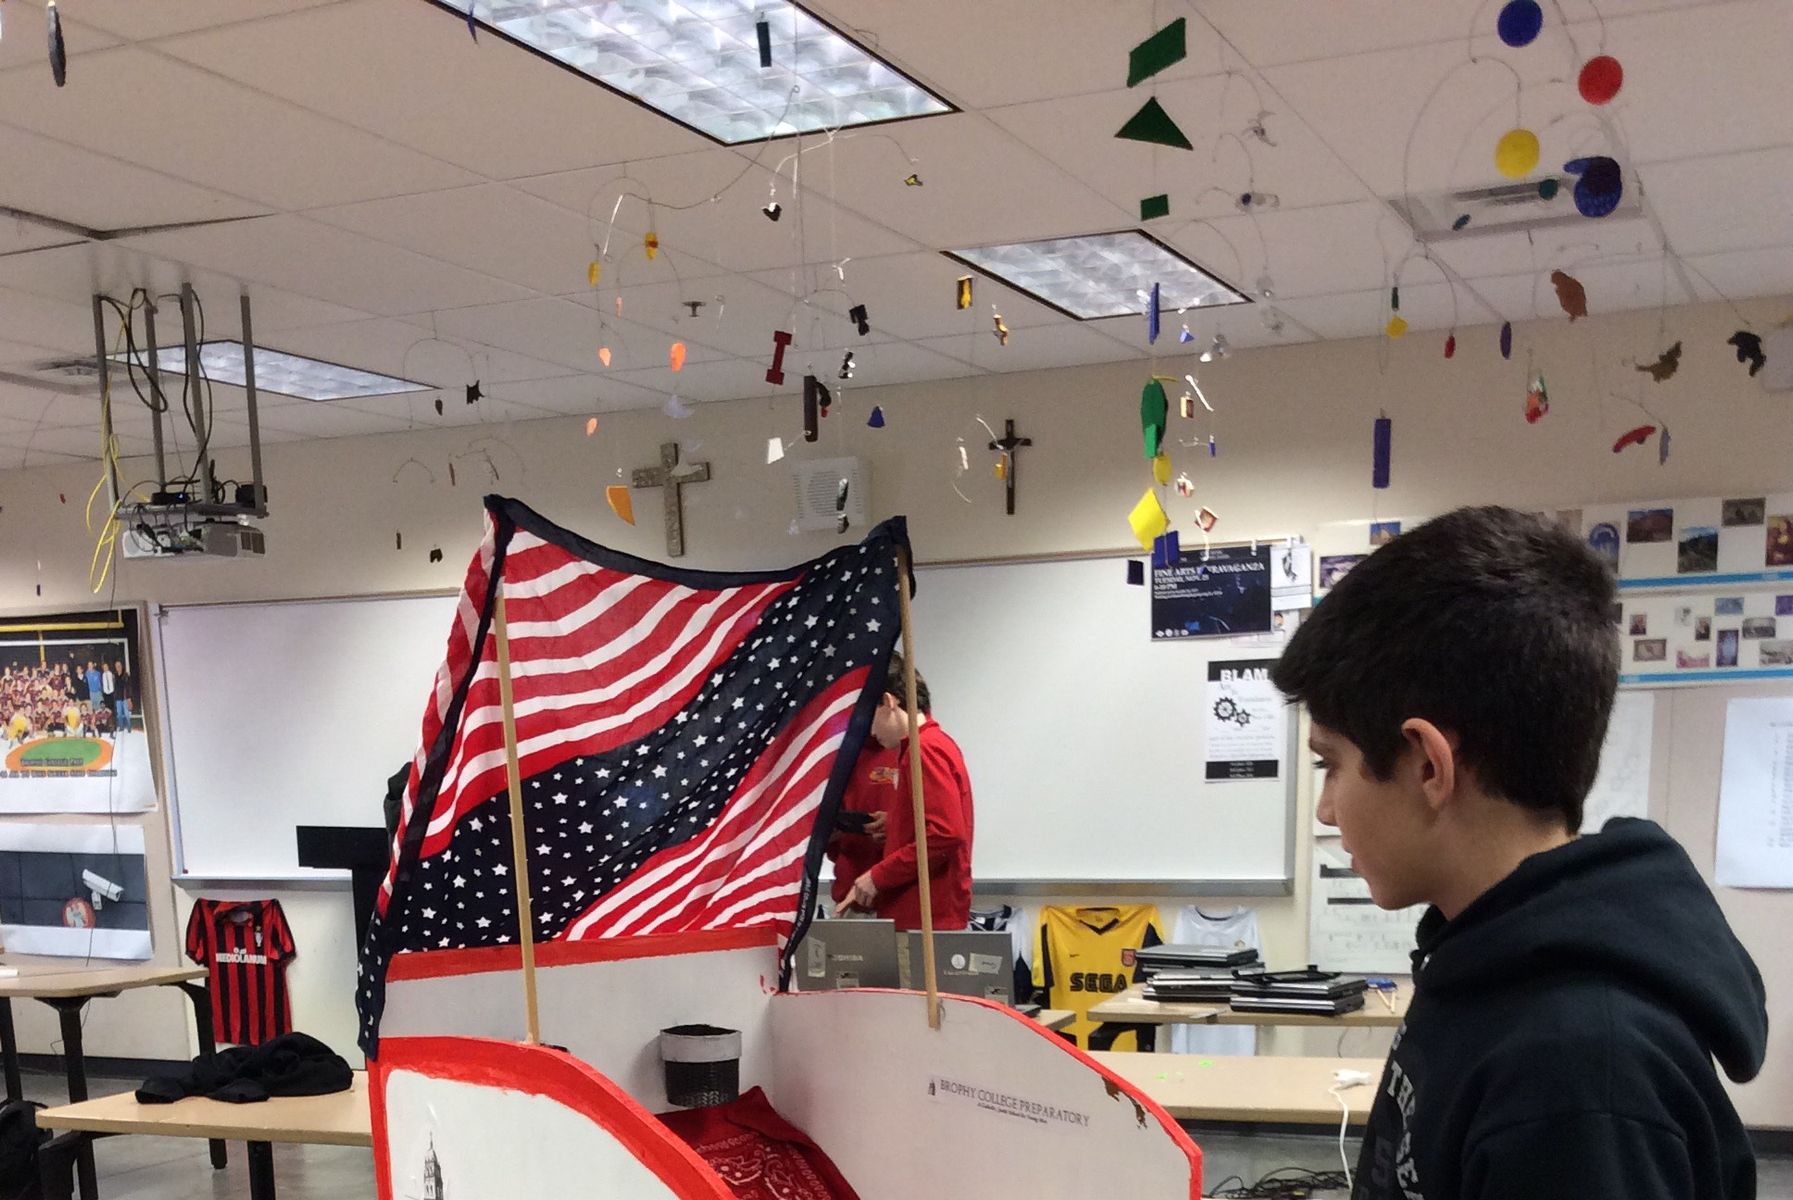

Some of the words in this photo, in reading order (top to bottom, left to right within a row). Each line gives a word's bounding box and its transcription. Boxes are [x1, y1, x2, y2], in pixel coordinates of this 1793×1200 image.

[1221, 668, 1269, 681] BLAM
[1070, 972, 1128, 993] SEGA
[940, 1079, 976, 1098] BROPHY
[978, 1089, 1018, 1109] COLLEGE
[1020, 1100, 1090, 1127] PREPARATORY
